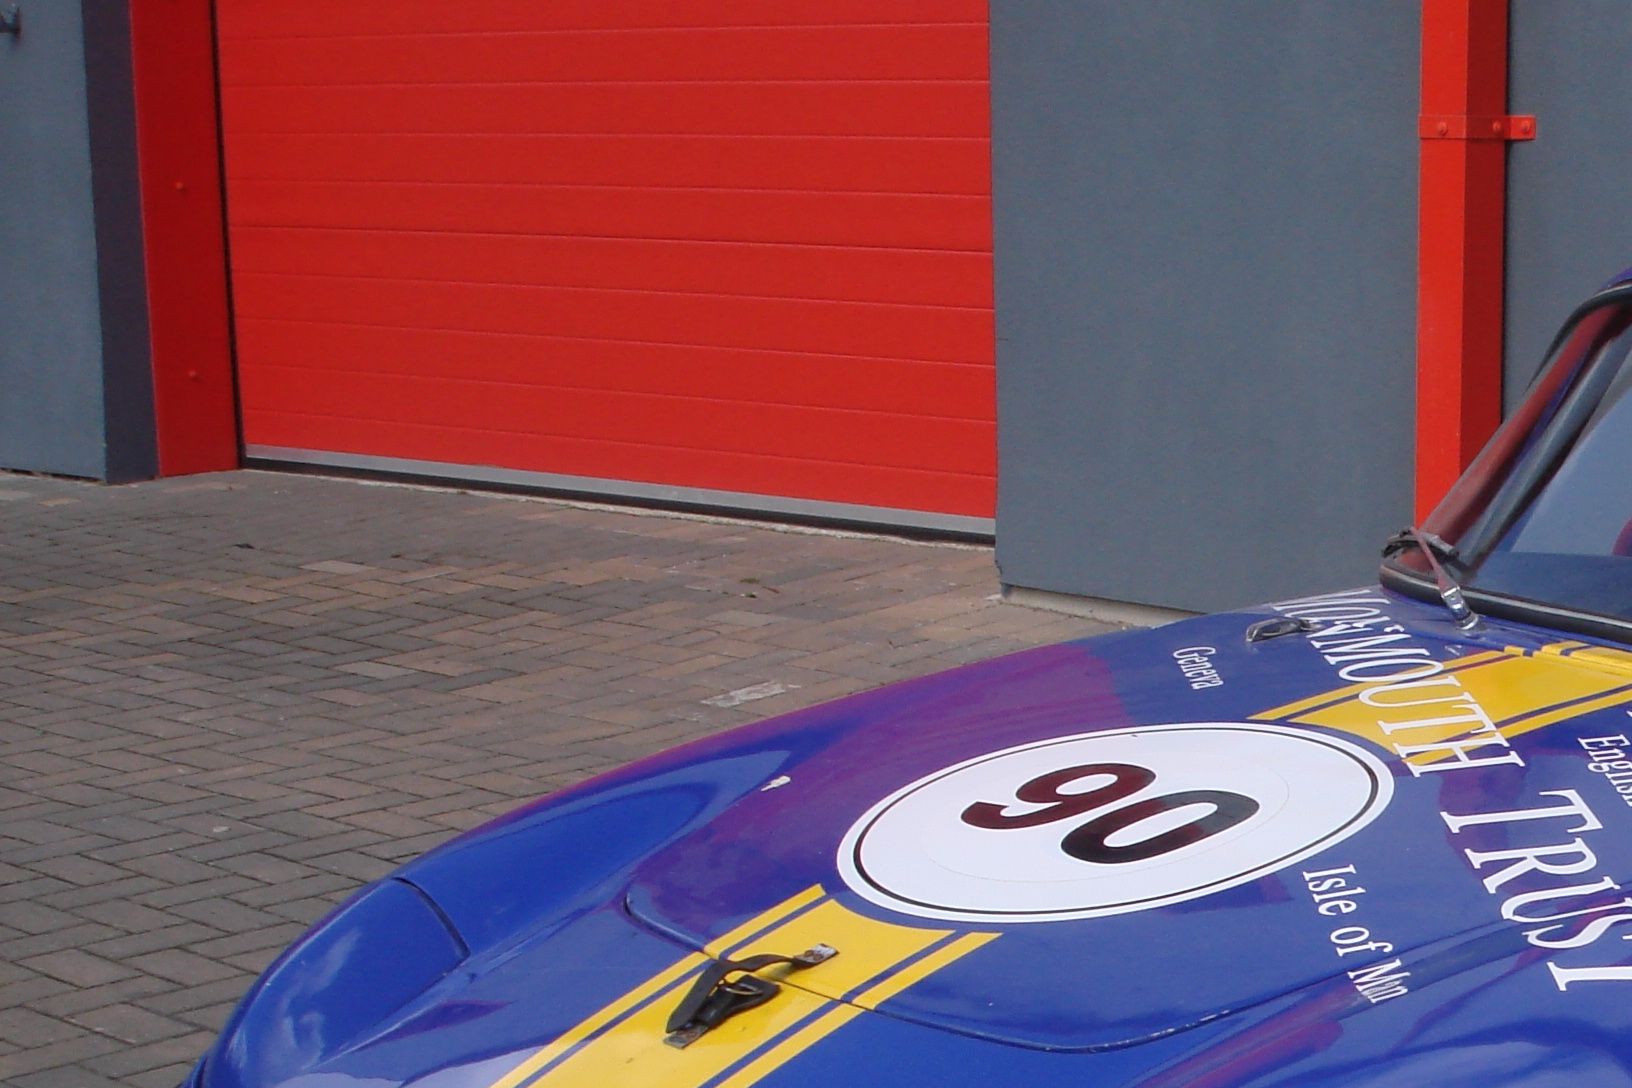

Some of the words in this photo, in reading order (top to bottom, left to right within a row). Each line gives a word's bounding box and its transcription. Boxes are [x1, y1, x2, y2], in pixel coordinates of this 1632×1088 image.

[1173, 646, 1223, 689] Geneva
[960, 762, 1260, 865] 90
[1302, 864, 1366, 916] Isle
[1330, 926, 1393, 957] of
